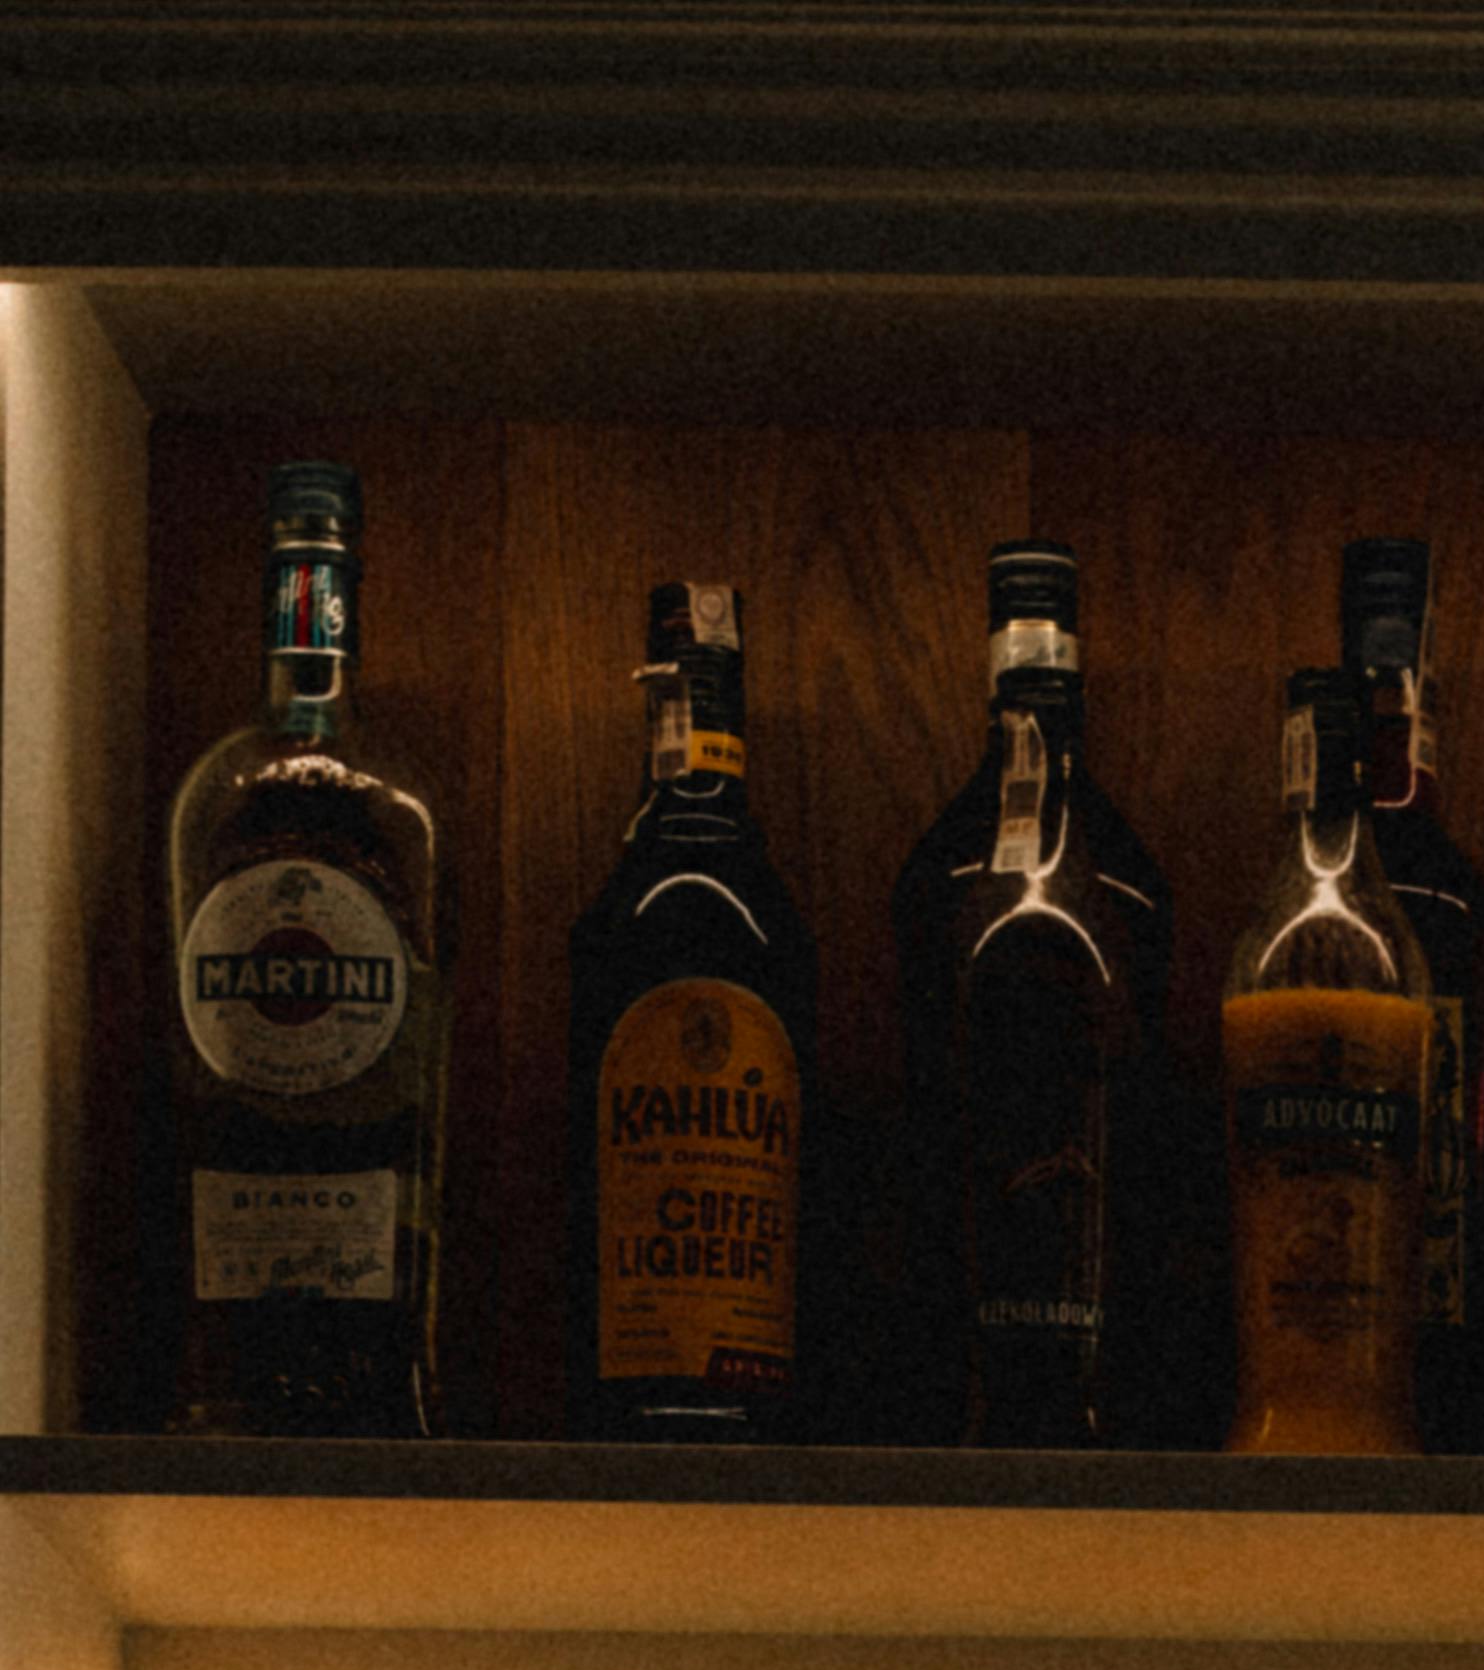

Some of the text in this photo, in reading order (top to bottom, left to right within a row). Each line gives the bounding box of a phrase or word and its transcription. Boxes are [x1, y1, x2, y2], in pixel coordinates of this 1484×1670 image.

[203, 958, 389, 999] MARTINI
[611, 1067, 791, 1157] KAHLÚA
[1263, 1098, 1398, 1133] ADVOCAAT
[232, 1190, 357, 1211] BIANCO
[658, 1187, 786, 1242] COFFEE
[617, 1235, 774, 1285] LIQUEUR
